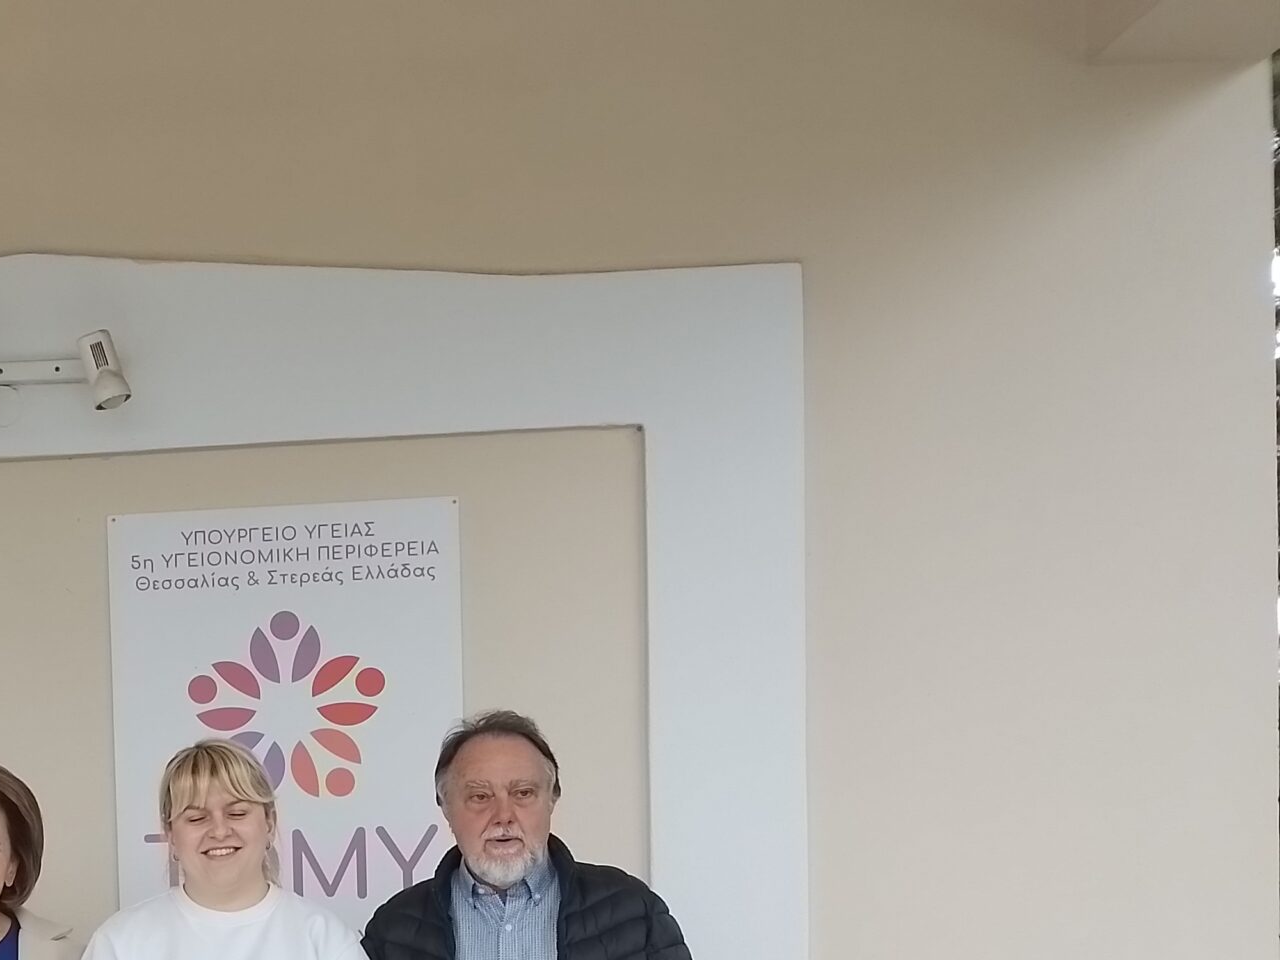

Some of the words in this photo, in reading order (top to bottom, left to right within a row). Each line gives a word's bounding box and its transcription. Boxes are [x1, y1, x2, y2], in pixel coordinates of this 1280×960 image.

[180, 525, 297, 546] ΥΠΟΥΡΓΕΙΟ
[304, 521, 376, 539] ΥΓΕΙΑΣ
[130, 555, 154, 573] 5η
[161, 547, 310, 569] ΥΓΕΙΟΝΟΜΙΚΗ
[318, 540, 440, 561] ΠΕΡΙΦΕΡΕΙΑ
[135, 571, 240, 592] Θεσσαλίας
[247, 572, 260, 586] &
[267, 566, 344, 588] Στερεάς
[352, 562, 436, 581] Ελλάδας
